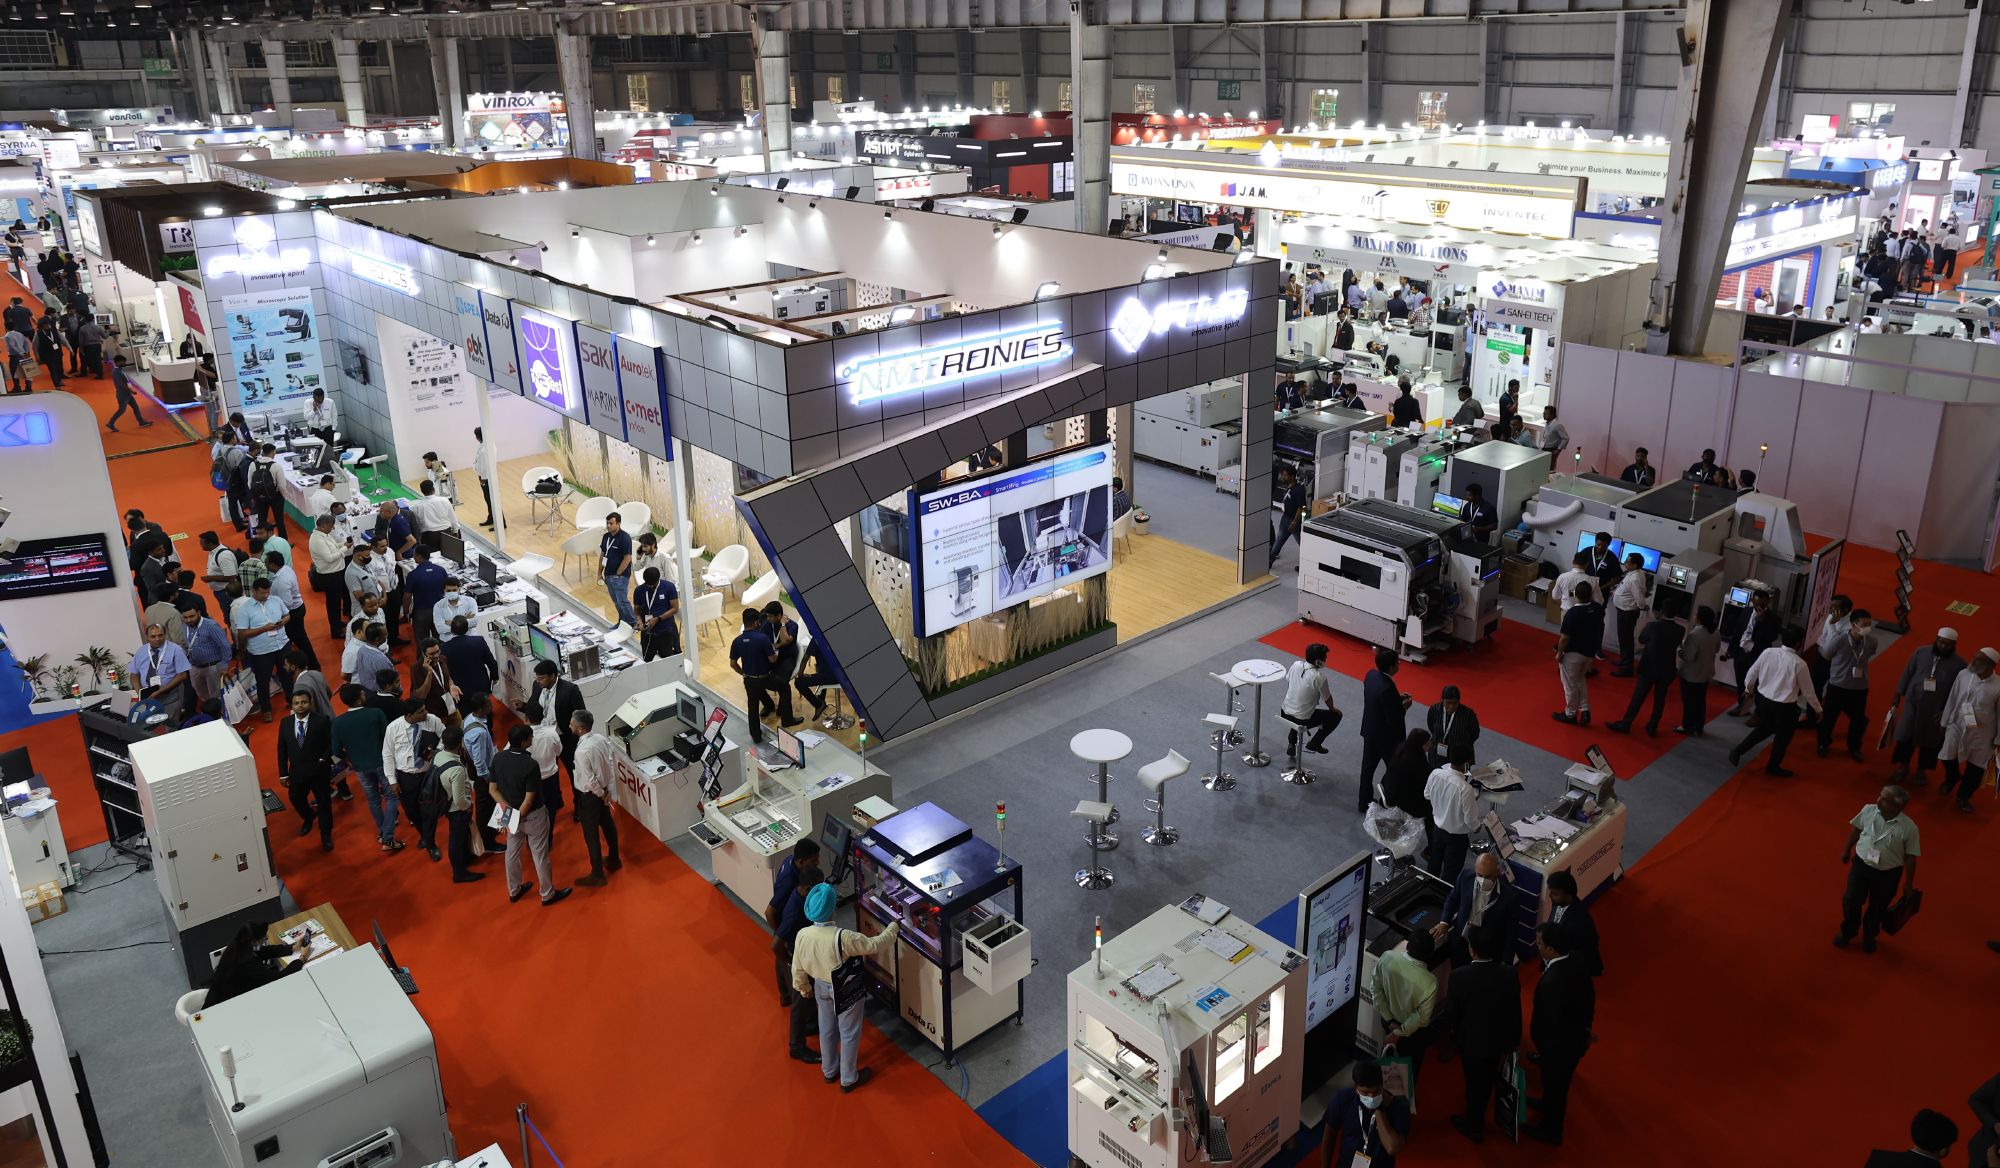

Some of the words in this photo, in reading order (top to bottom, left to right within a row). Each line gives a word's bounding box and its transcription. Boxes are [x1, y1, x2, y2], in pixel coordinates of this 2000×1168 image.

[109, 112, 143, 121] vonRoll
[0, 141, 37, 149] SYRMA
[1, 148, 23, 156] SGS
[291, 148, 336, 158] Sahasra
[1569, 165, 1586, 173] your
[1588, 165, 1624, 175] Business.
[1625, 168, 1661, 177] Maximize
[1171, 177, 1196, 190] UNIX
[1239, 185, 1268, 199] J.A.M.
[1429, 200, 1449, 214] ECO
[1483, 207, 1548, 221] INVENTEC
[1352, 235, 1394, 253] MAXIM
[250, 271, 286, 281] innovative
[287, 270, 305, 279] spirit
[1508, 283, 1545, 298] MAXIM
[256, 297, 287, 305] Microscopy
[287, 294, 309, 302] Solution
[484, 308, 501, 327] Data
[1507, 307, 1532, 319] SAN-EI
[1533, 311, 1553, 323] TECH
[1191, 323, 1223, 337] innovative
[1223, 319, 1240, 330] spirit
[856, 331, 1064, 396] NMTRONICS
[928, 490, 981, 512] SW-BA
[908, 1007, 926, 1028] Data
